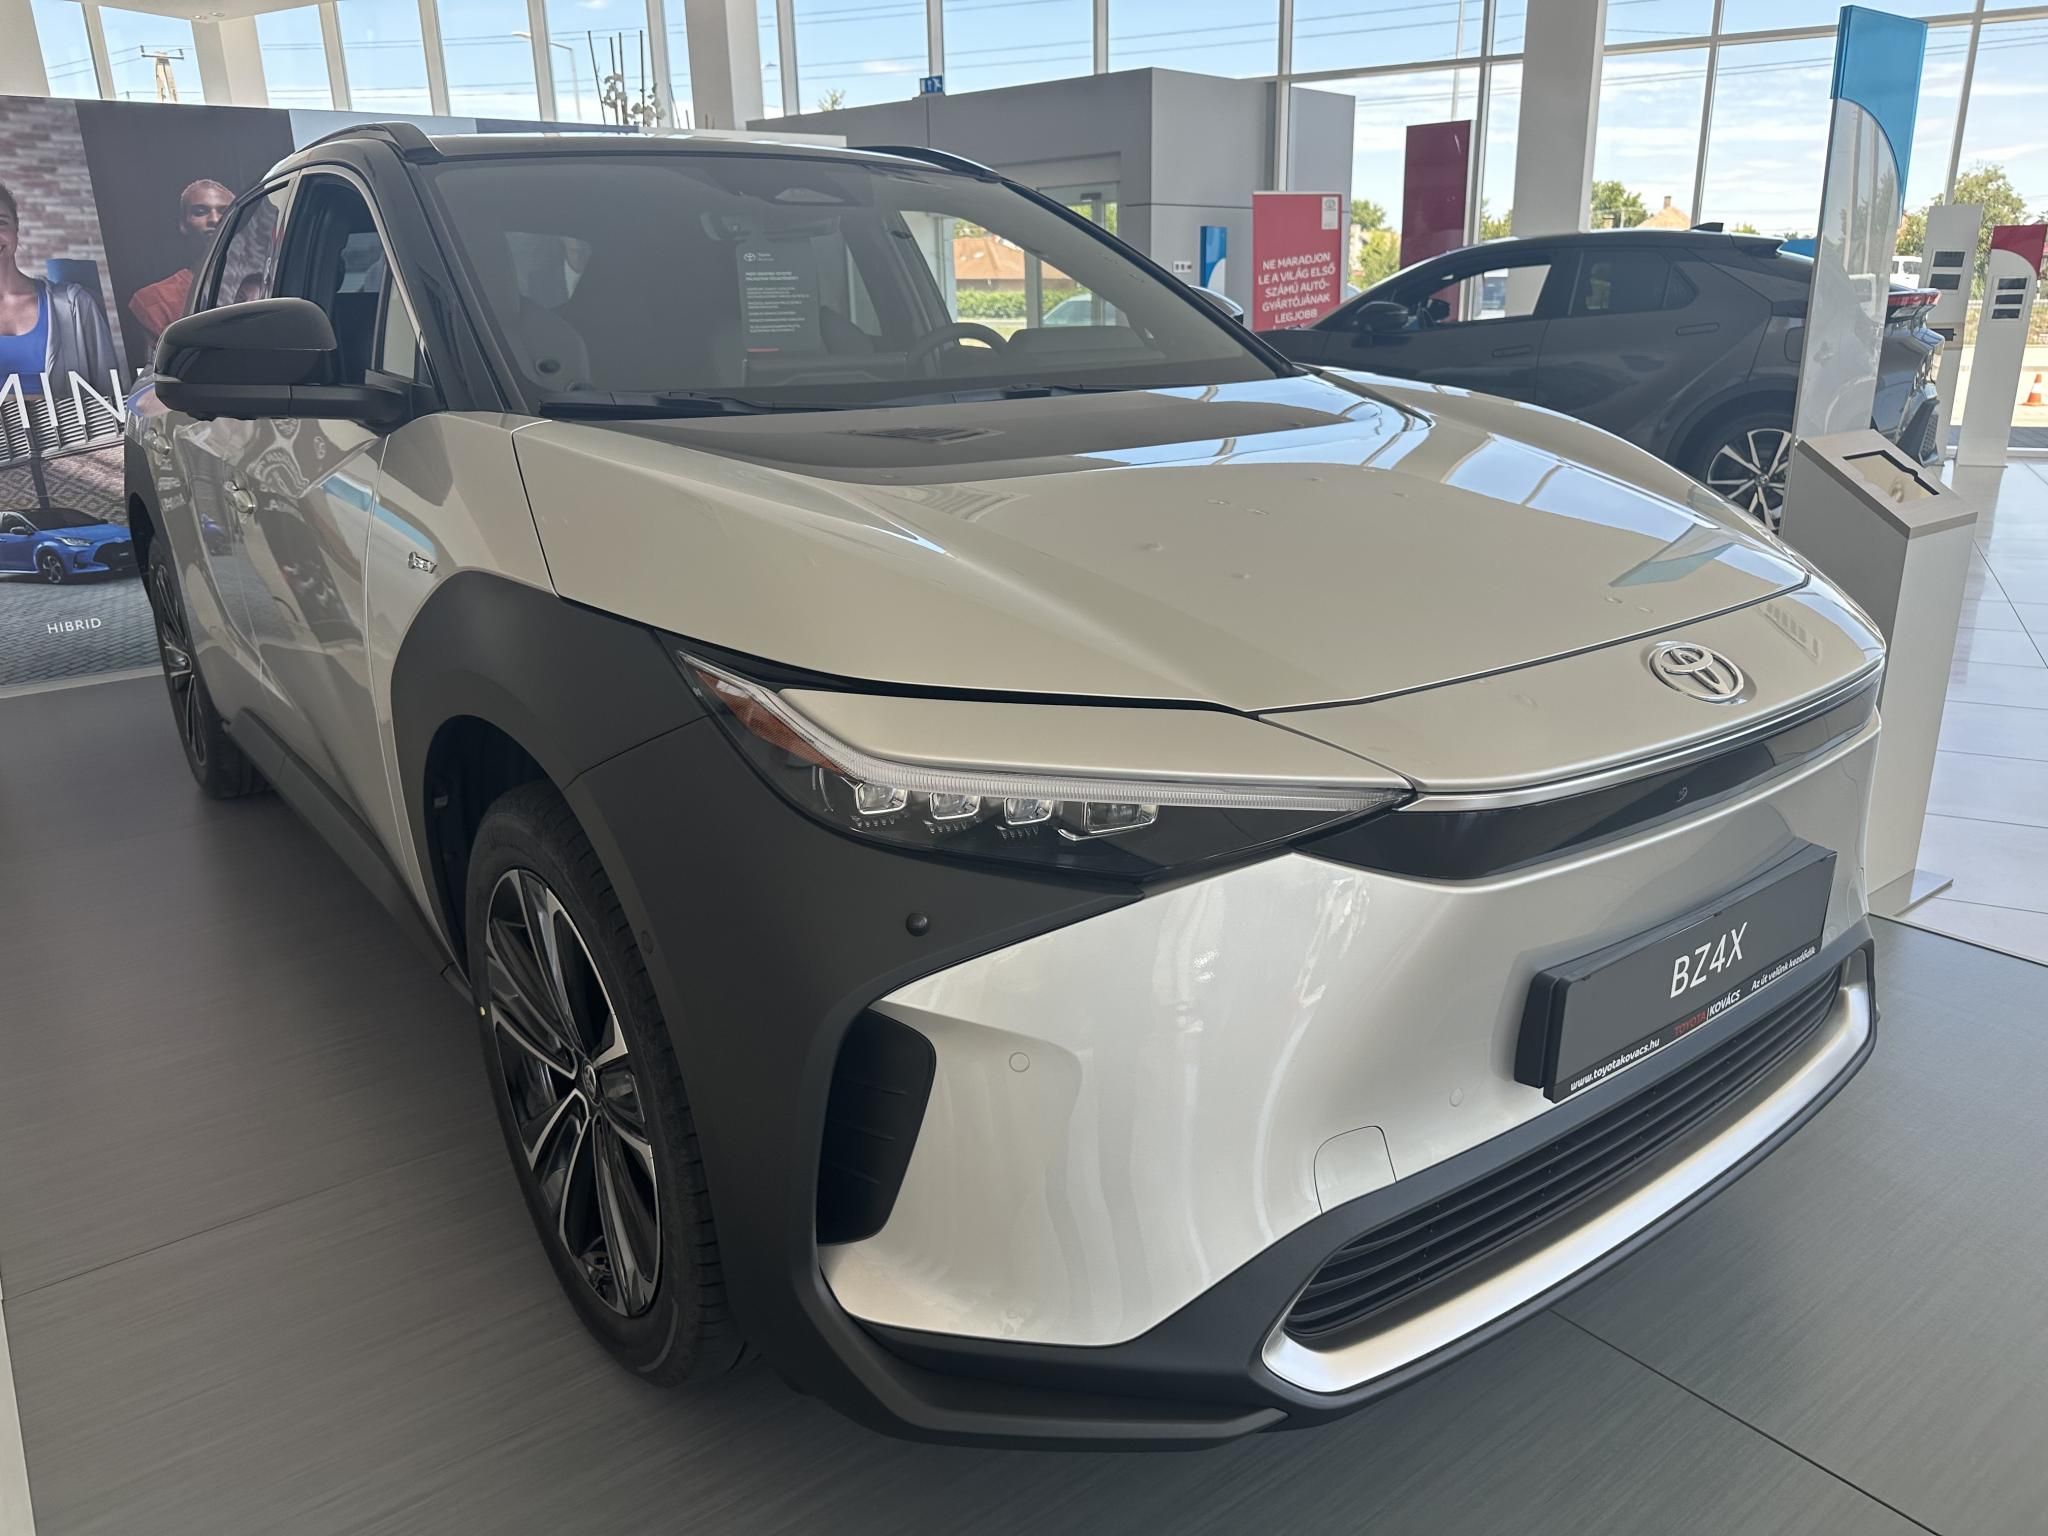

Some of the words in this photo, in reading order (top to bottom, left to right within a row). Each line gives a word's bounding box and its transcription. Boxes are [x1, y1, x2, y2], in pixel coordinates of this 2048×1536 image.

[1262, 259, 1277, 271] NE
[1277, 252, 1331, 269] MARADJON
[1258, 274, 1270, 285] LE
[1271, 273, 1279, 282] A
[1280, 267, 1309, 281] VILÁG
[1310, 262, 1336, 278] ELSŐ
[1265, 282, 1299, 298] SZÁMÚ
[1300, 278, 1330, 293] AUTÓ-
[1262, 293, 1330, 312] GYÁRTÓJÁNAK
[1274, 309, 1318, 323] LEGJOBB
[47, 617, 102, 634] HIBRID
[1670, 921, 1748, 999] BZ4X
[1751, 980, 1761, 991] Az
[1768, 962, 1789, 981] velünk
[1788, 946, 1816, 968] kezdődik
[1709, 989, 1741, 1016] KOVÁCS
[1570, 1038, 1660, 1091] www.toyotakovacs.hu
